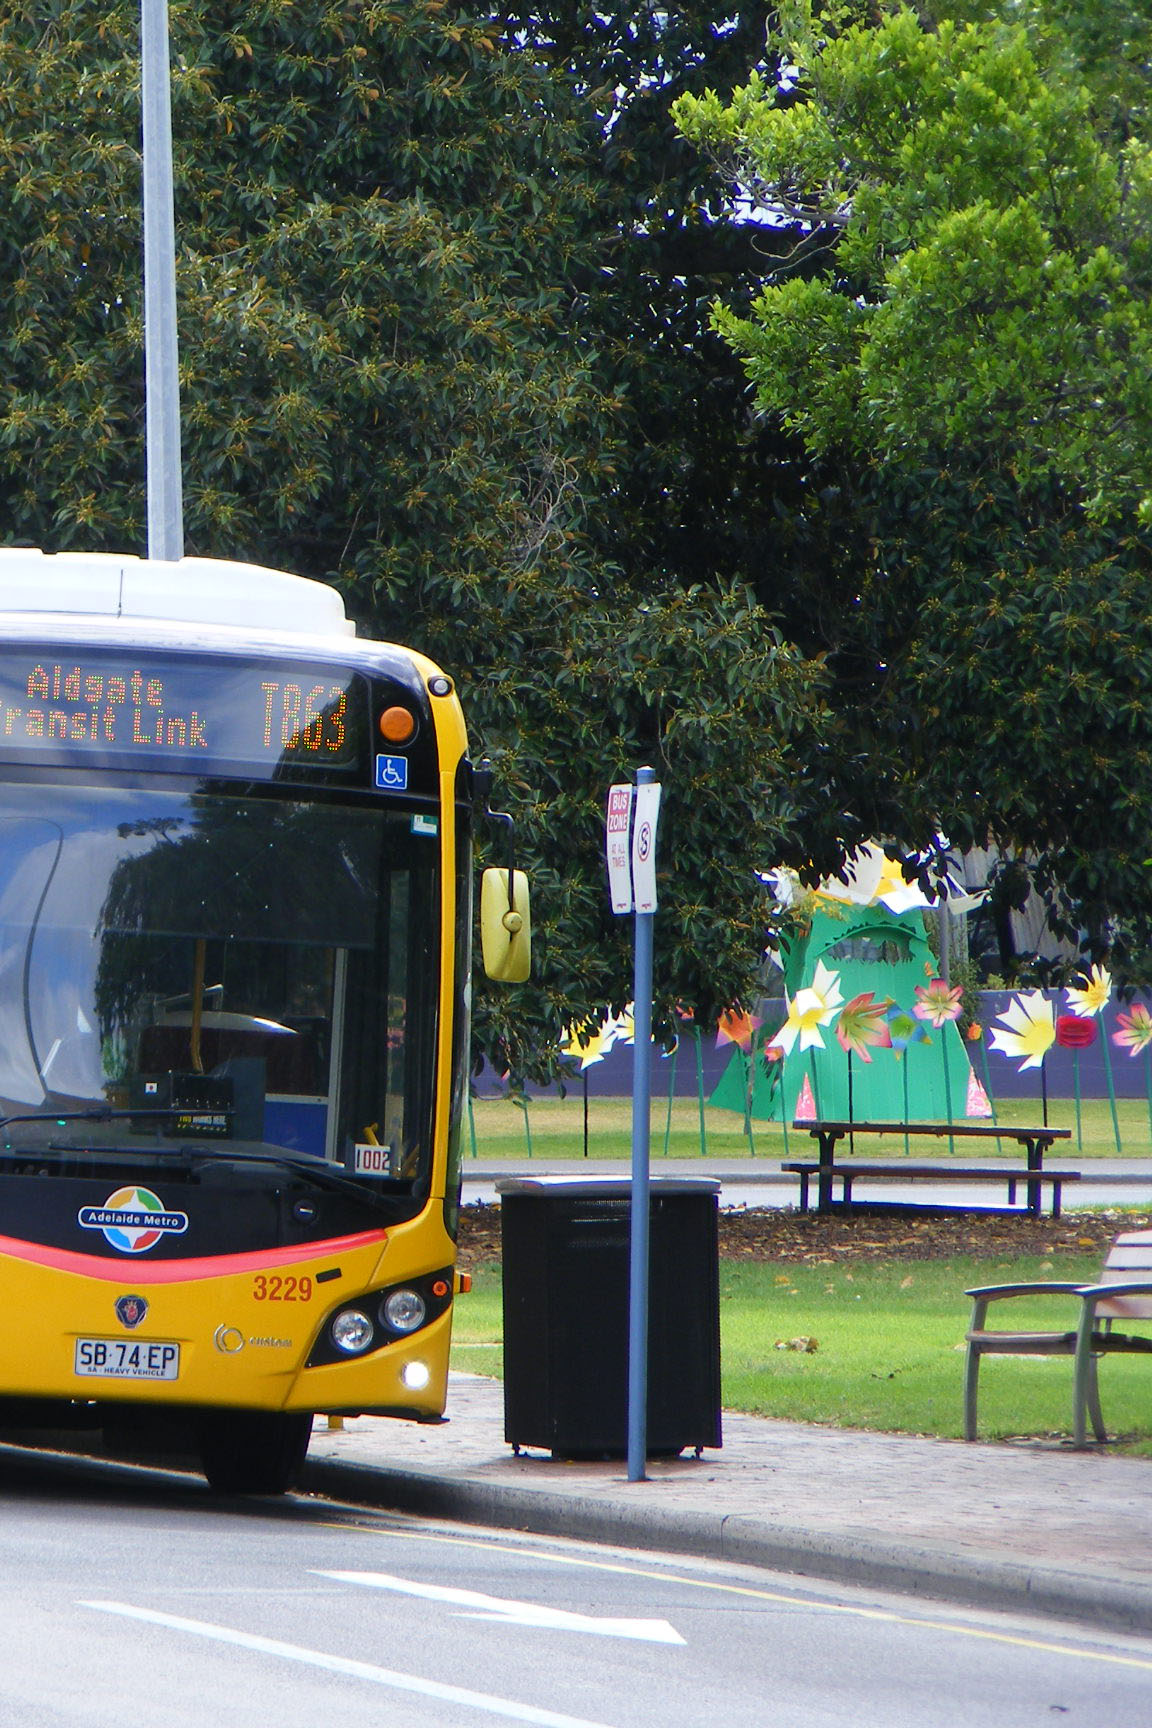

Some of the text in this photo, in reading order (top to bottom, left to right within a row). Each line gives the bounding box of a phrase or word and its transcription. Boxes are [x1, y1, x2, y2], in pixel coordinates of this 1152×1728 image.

[26, 664, 164, 706] Aldgate
[261, 682, 347, 751] T863
[133, 708, 208, 748] Link
[612, 794, 628, 811] BUS
[608, 814, 627, 831] ZONE
[612, 856, 625, 868] TIMES
[88, 1211, 179, 1226] Adelaide Metro
[253, 1275, 312, 1302] 3229
[104, 1367, 131, 1375] HEAVY
[133, 1368, 166, 1377] VEHICLE
